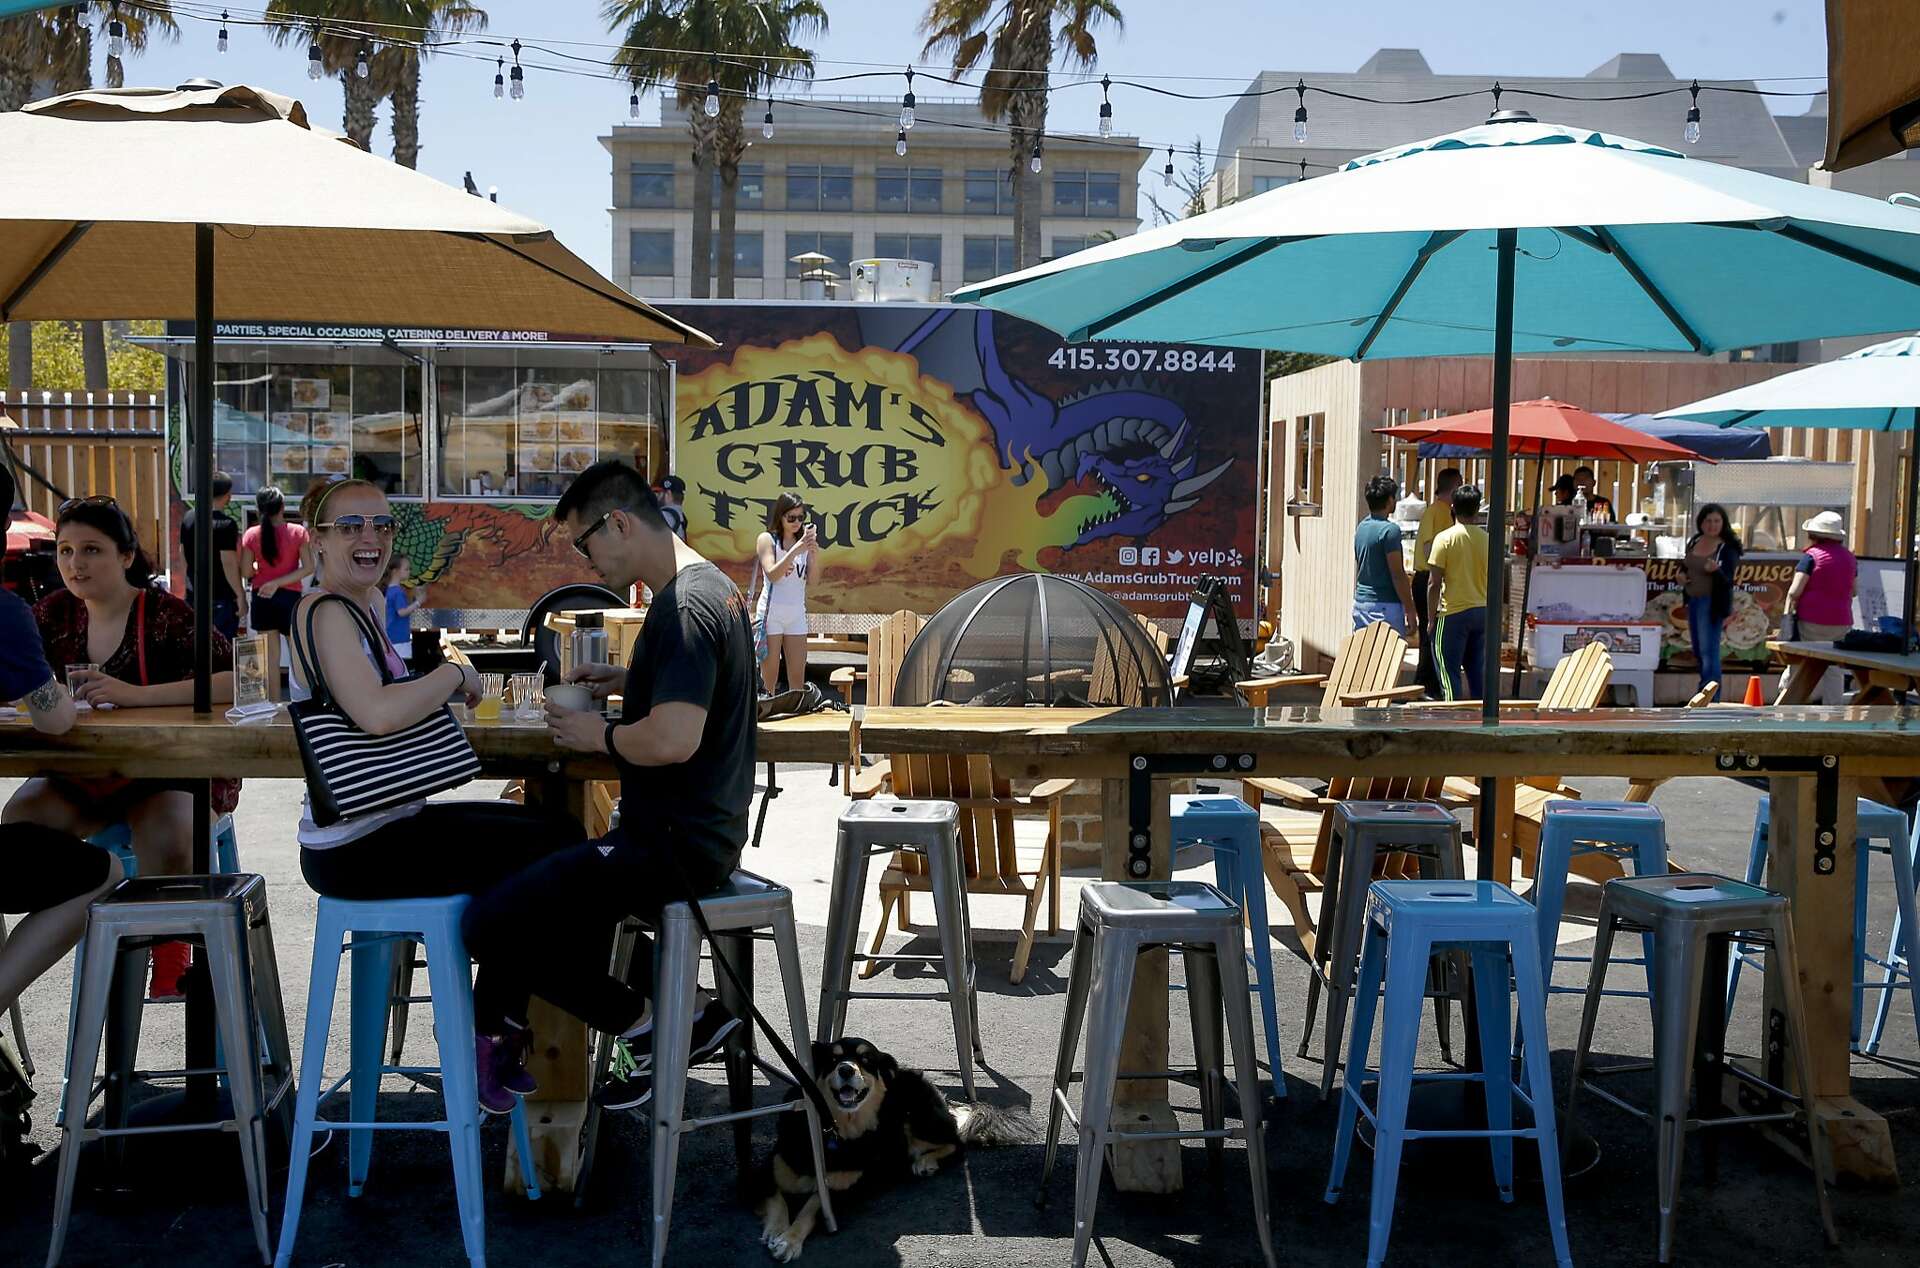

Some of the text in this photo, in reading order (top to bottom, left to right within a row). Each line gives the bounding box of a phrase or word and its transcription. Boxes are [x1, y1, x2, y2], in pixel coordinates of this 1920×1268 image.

[217, 325, 548, 341] PARTIES, SPECIAL OCCASIONS, CATERING DELIVERY & MORE!
[1048, 347, 1236, 372] 415.307.8844
[682, 370, 947, 448] ADAM'S
[716, 439, 920, 489] GRUB
[1188, 548, 1227, 567] yelp
[1647, 581, 1665, 591] The
[1743, 583, 1768, 592] Town
